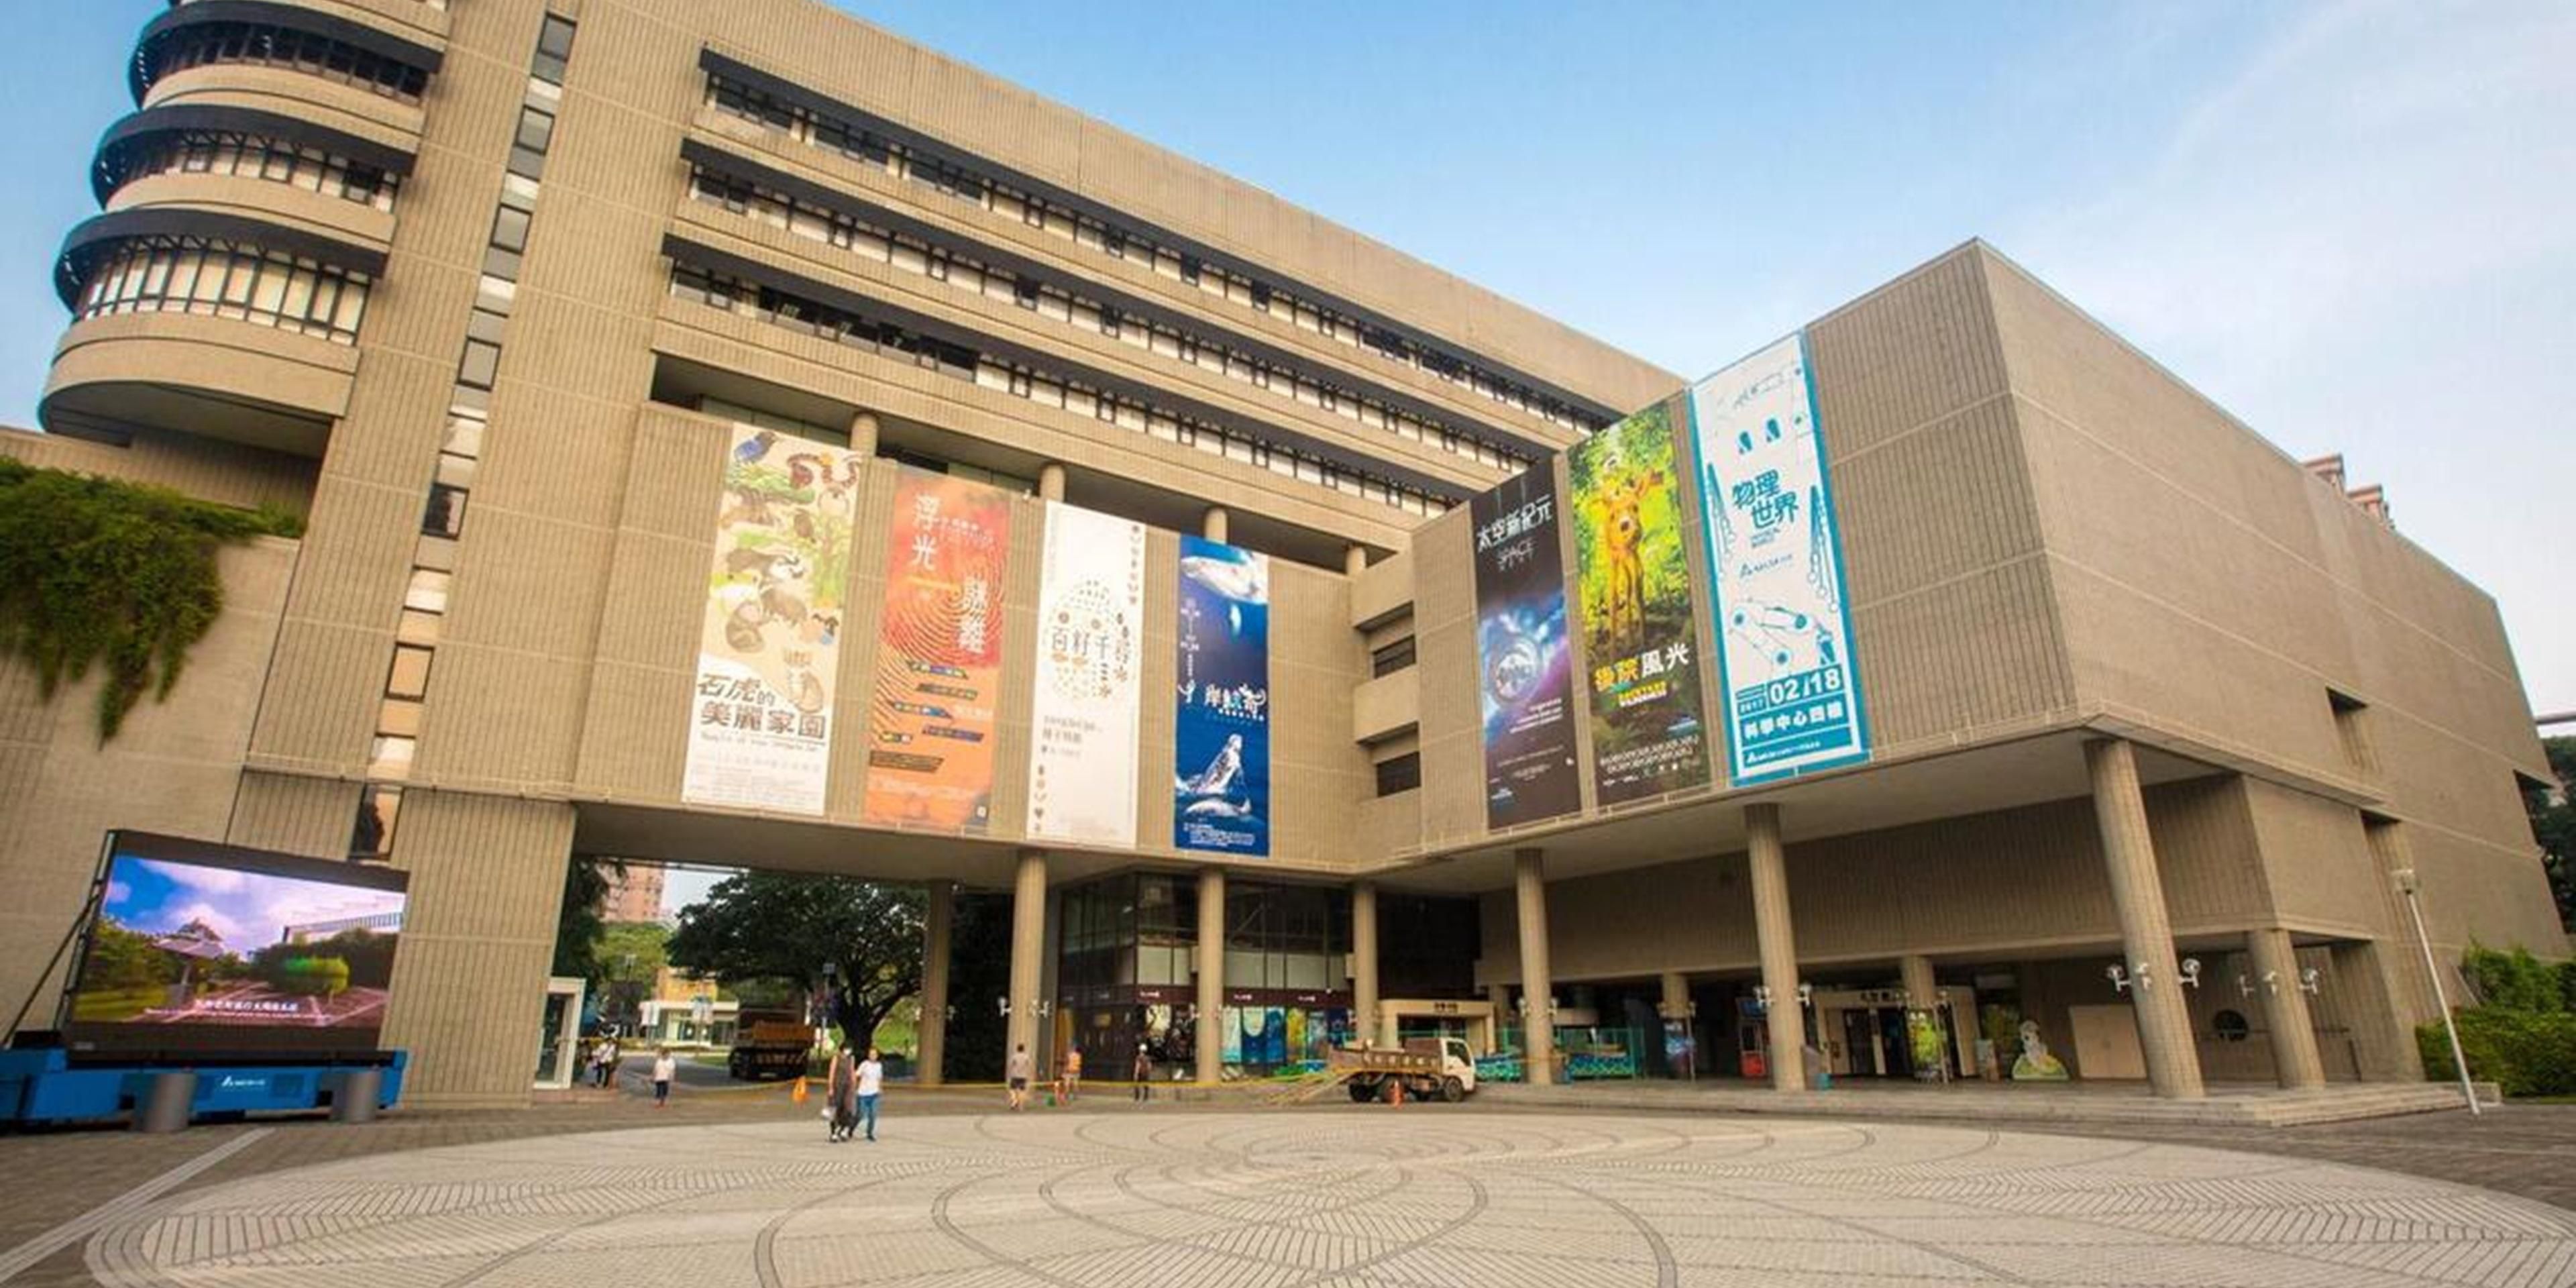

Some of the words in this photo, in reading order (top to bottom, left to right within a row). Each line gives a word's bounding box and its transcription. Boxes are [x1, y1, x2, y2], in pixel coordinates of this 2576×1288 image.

[1733, 470, 1780, 509] 物理
[1752, 490, 1799, 529] 世界
[912, 494, 938, 570] 浮光
[698, 673, 775, 706] 石虎的
[1770, 669, 1841, 704] 02/18
[700, 702, 826, 739] 美麗家園
